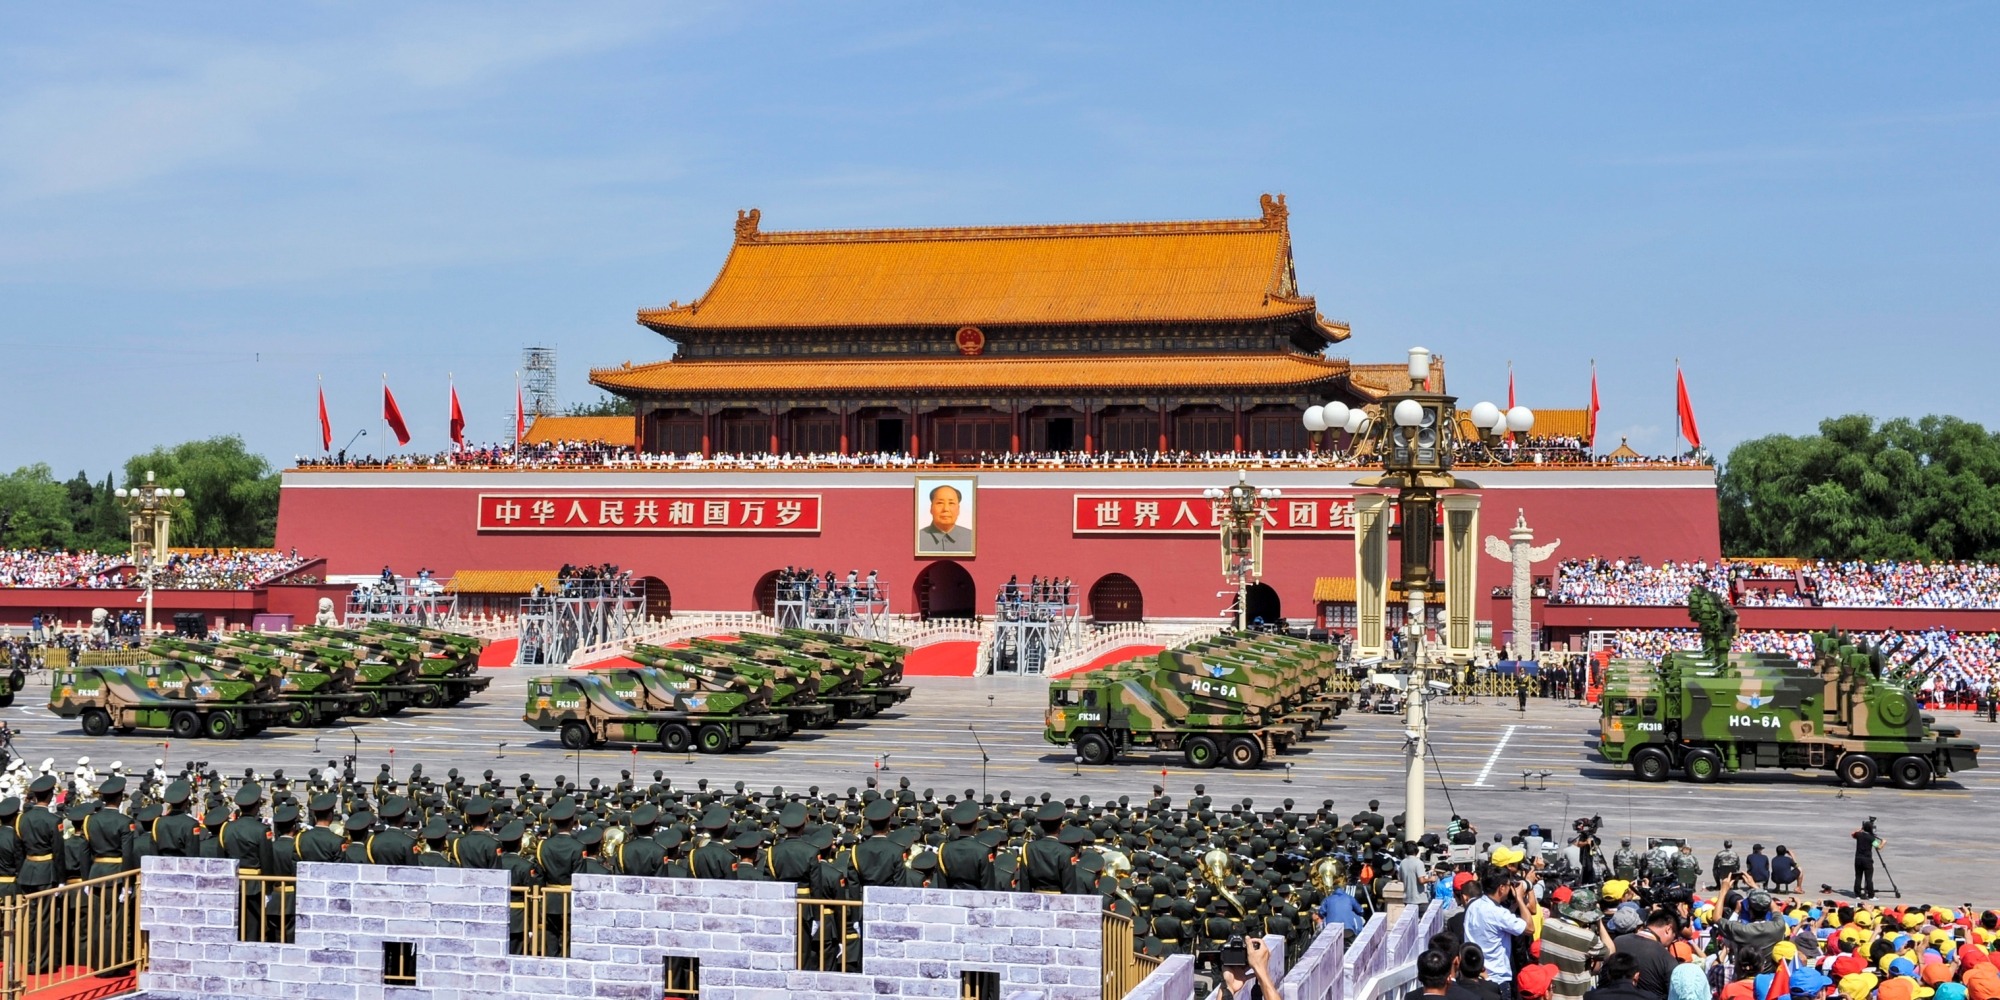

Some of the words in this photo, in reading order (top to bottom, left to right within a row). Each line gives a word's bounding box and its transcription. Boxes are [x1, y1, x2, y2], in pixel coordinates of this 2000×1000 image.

[495, 500, 803, 527] 中华人民共和国万岁
[1094, 500, 1441, 529] 世界人民大团结
[194, 655, 222, 667] HQ-12
[683, 664, 713, 677] HQ-12
[1191, 679, 1237, 698] HQ-6A
[1078, 713, 1101, 721] FK314
[1730, 715, 1781, 728] HQ-6A
[1638, 722, 1663, 731] FK318
